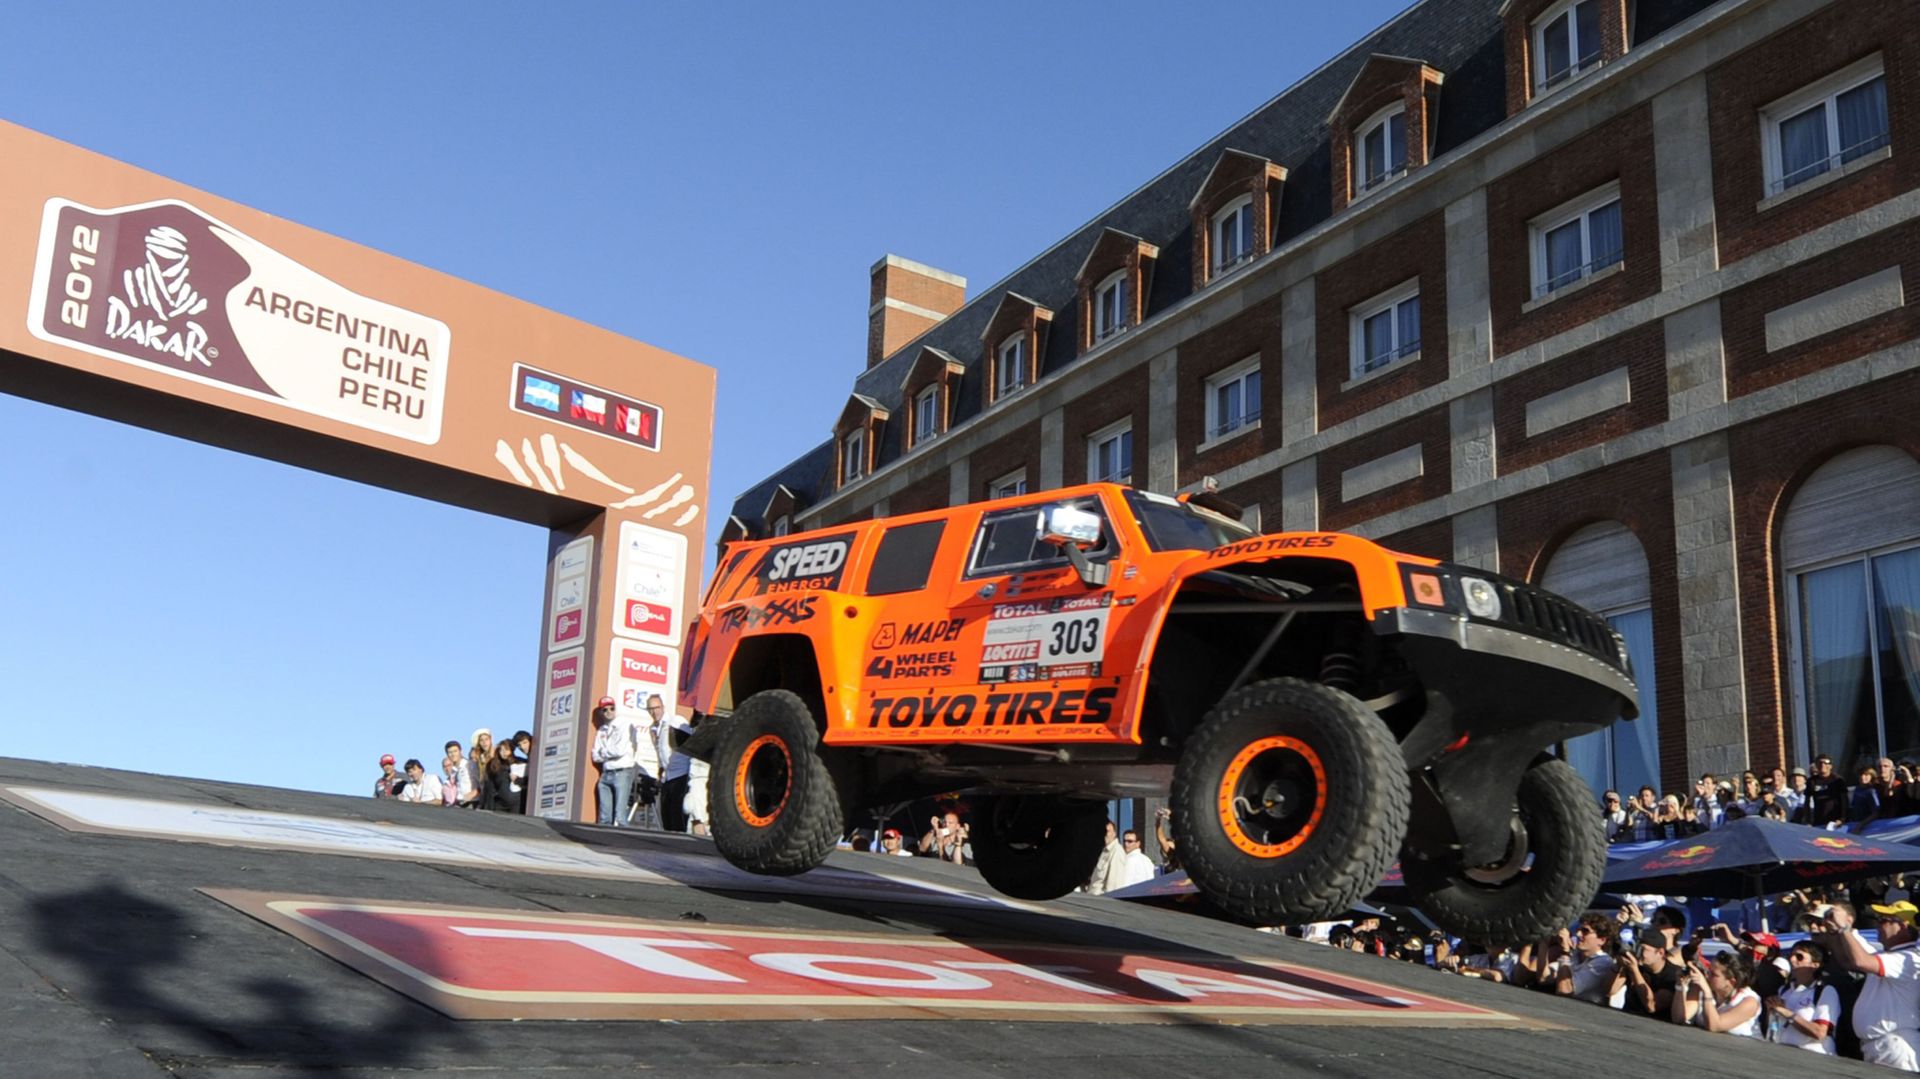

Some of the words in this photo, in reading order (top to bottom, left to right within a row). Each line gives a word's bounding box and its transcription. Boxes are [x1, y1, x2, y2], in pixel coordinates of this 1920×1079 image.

[61, 224, 100, 328] 2012
[106, 296, 212, 367] DAKAR
[245, 286, 430, 361] ARGENTINA
[342, 347, 427, 391] CHILE
[338, 377, 425, 420] PERU
[769, 541, 847, 580] SPEED
[1207, 541, 1262, 560] TOYO
[1266, 536, 1338, 551] TIRES
[767, 577, 833, 593] ENERGY
[720, 596, 819, 633] TRAXXAS
[993, 602, 1047, 618] TOTAL
[1063, 598, 1099, 609] TOTAL
[899, 619, 966, 645] MAPEI
[1049, 617, 1100, 656] 303
[623, 657, 666, 675] TOTAL
[865, 656, 894, 679] 4
[896, 652, 957, 665] WHEEL
[983, 642, 1038, 661] LOCTITE
[552, 668, 576, 680] TOTAL
[893, 666, 952, 679] PARTS
[868, 694, 977, 728] TOYO
[983, 688, 1118, 726] TIRES
[448, 926, 1424, 1005] TOTAL
